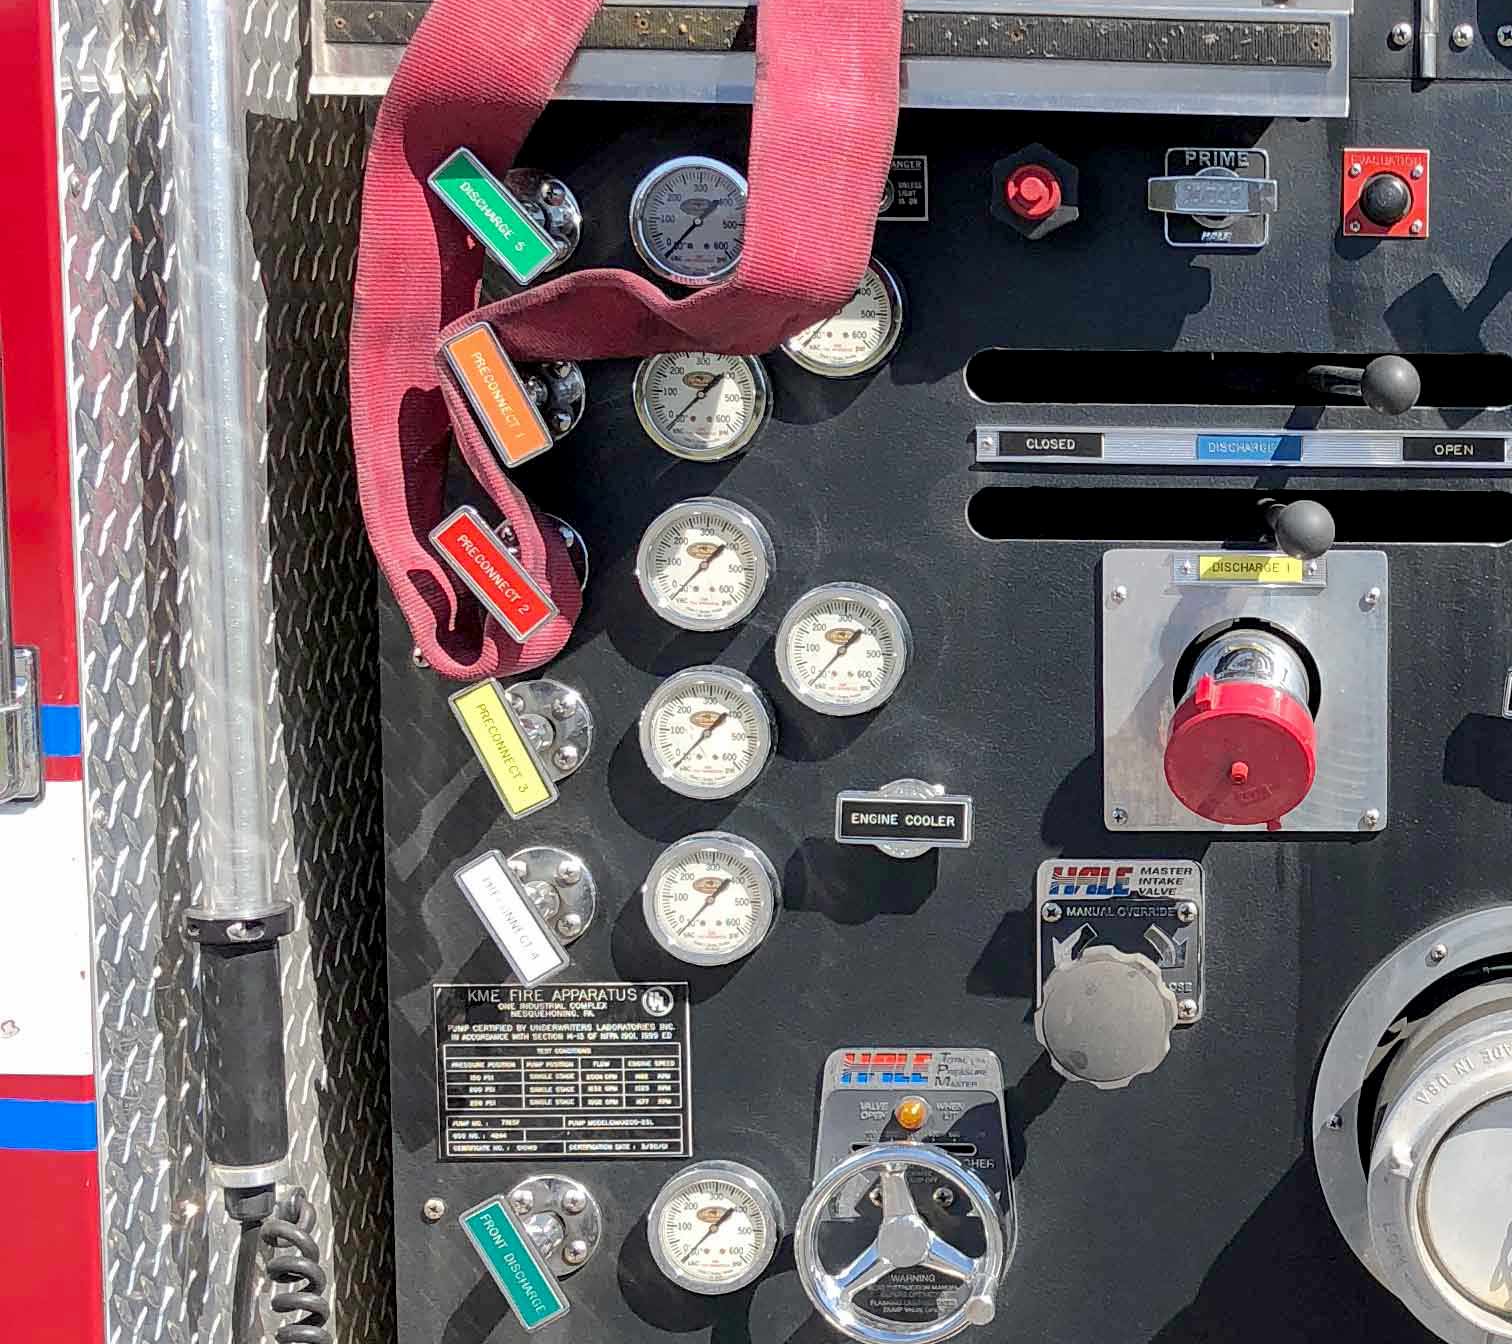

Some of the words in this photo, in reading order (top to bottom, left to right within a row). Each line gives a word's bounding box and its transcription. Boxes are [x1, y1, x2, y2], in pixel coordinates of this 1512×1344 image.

[1185, 151, 1250, 168] PRIME
[460, 182, 514, 241] DISCHARGE
[472, 352, 522, 430] PRECONNECT
[1026, 438, 1076, 450] CLOSED
[1208, 442, 1277, 454] DISCHARGE
[1434, 444, 1474, 456] OPEN
[456, 534, 522, 604] PRECONNECT
[1212, 562, 1282, 574] DISCHARGE
[478, 704, 522, 780] PRECONNECT
[850, 812, 899, 826] ENGINE
[904, 814, 956, 827] COOLER
[1140, 866, 1193, 876] MASTER
[1050, 866, 1133, 896] HALE
[1138, 877, 1184, 886] INTAKE
[1136, 887, 1176, 896] VALVE
[1066, 906, 1113, 917] MANUAL
[1117, 906, 1178, 918] OVERRIDE
[468, 990, 500, 1002] KME
[510, 989, 544, 1002] FIRE
[552, 988, 638, 1002] APPARATUS
[479, 1213, 508, 1251] FRONT
[503, 1251, 546, 1315] DISCHARGE
[891, 1274, 936, 1284] WARNING
